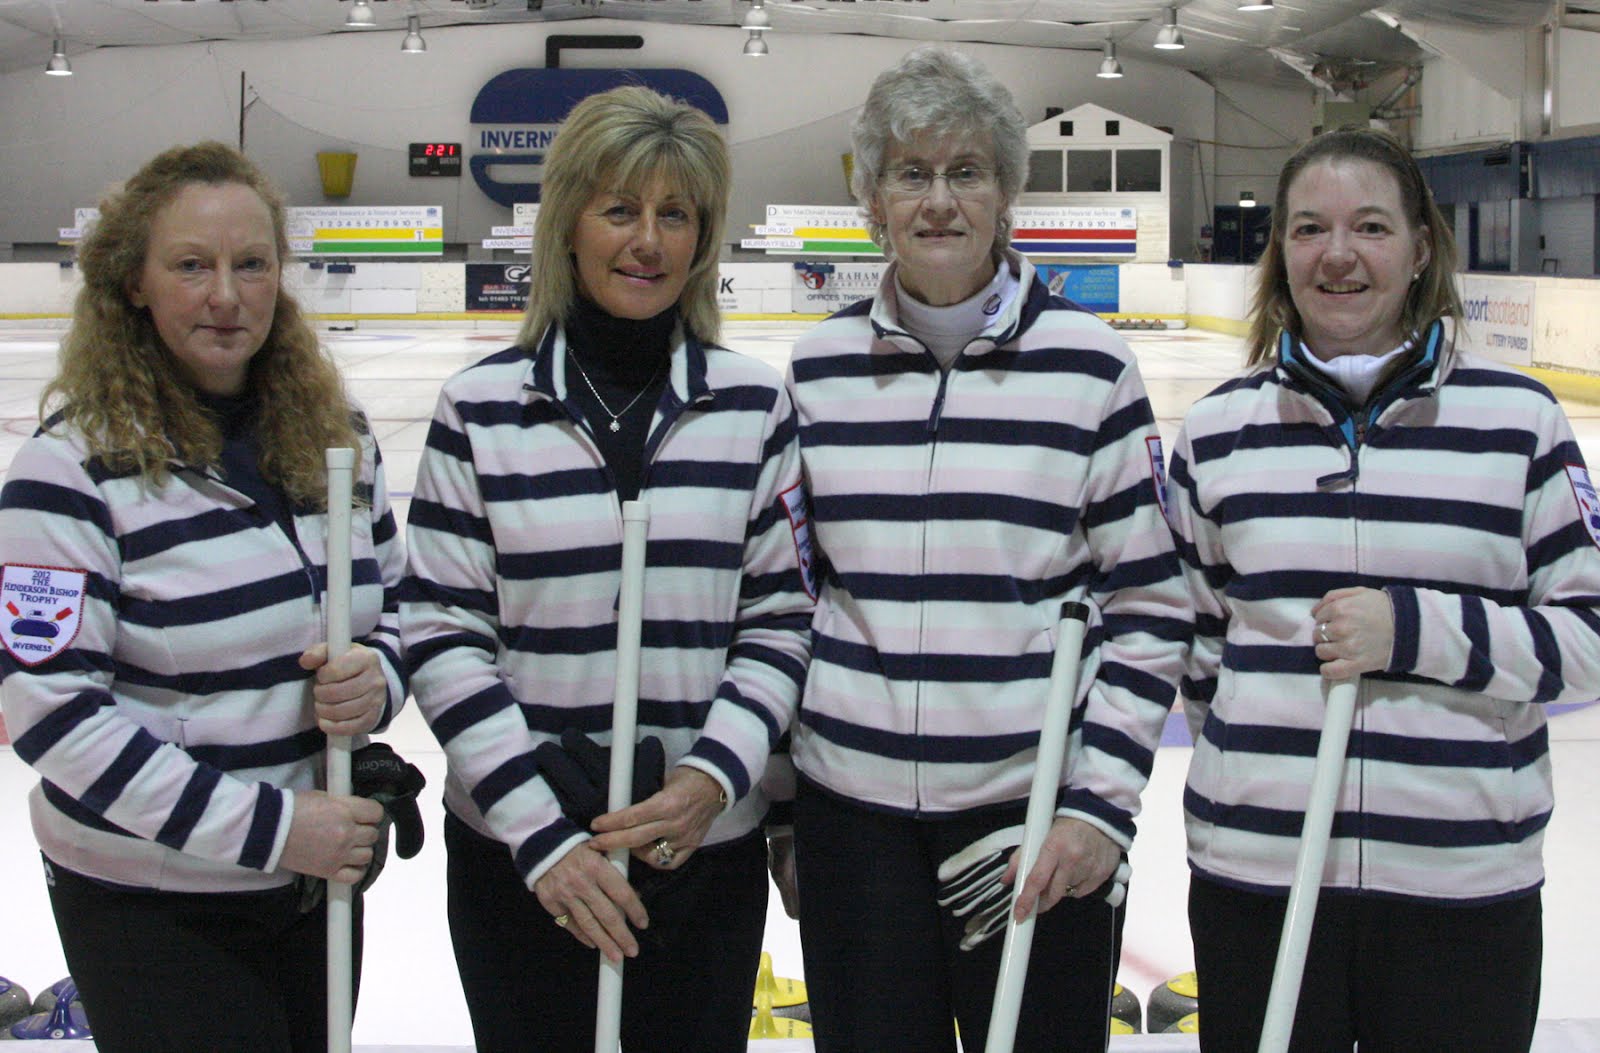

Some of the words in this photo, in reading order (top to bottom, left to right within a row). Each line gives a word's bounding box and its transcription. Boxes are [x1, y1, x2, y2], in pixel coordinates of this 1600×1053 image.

[481, 130, 556, 148] INVERN
[516, 206, 524, 214] C
[768, 207, 776, 216] D
[417, 231, 422, 240] T
[828, 272, 879, 280] GRAHAM
[34, 570, 51, 579] 2012
[32, 578, 50, 586] THE
[4, 582, 48, 594] HENDERSON
[49, 586, 79, 598] BISHOP
[20, 592, 59, 605] TROPHY
[12, 642, 52, 652] INVERNESS
